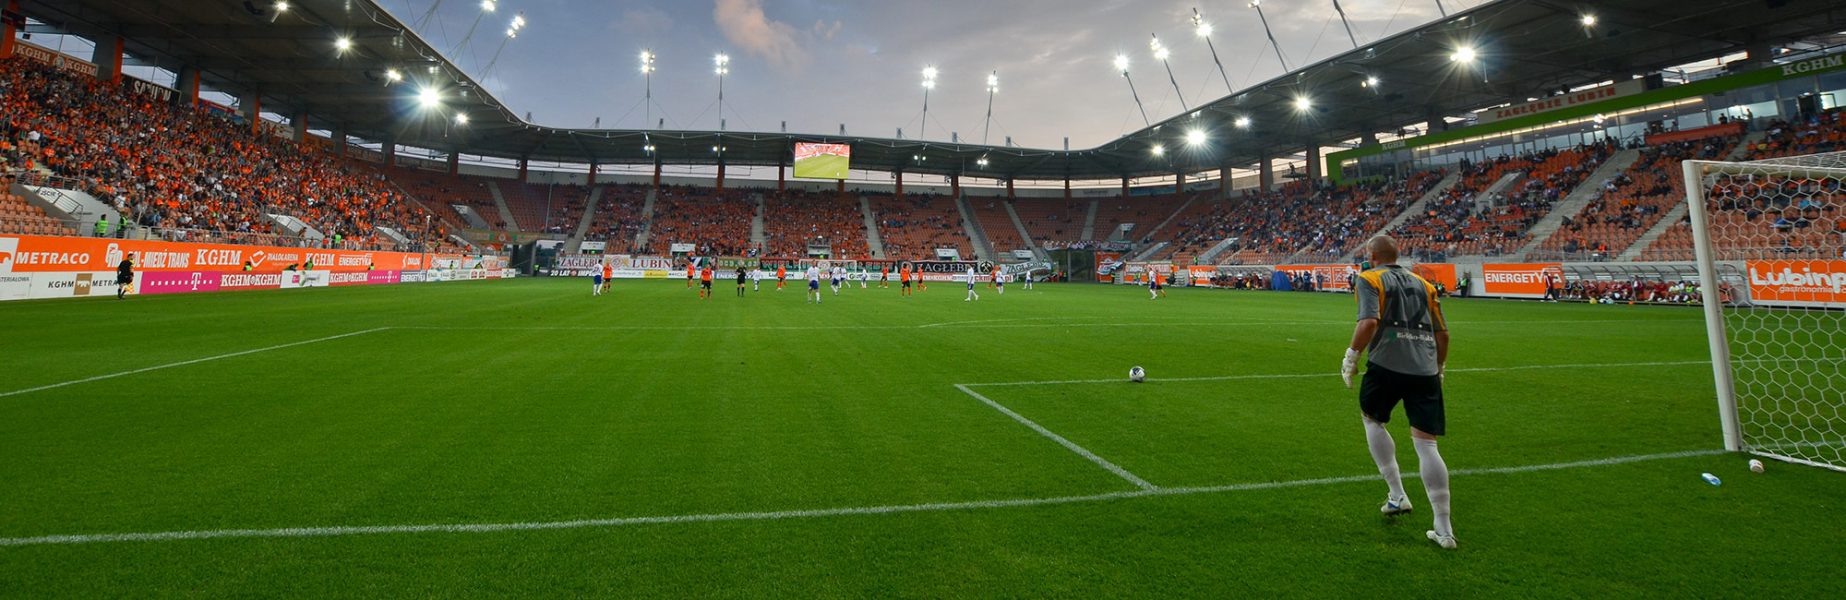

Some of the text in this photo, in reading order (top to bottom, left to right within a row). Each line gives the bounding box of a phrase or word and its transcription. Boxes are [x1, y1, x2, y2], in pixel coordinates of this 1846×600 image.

[17, 44, 97, 76] KGHM KGHM
[1782, 55, 1844, 76] KGHM
[1567, 87, 1616, 105] LUBIN
[15, 251, 90, 265] METRACO
[167, 252, 190, 268] TRANS
[195, 249, 242, 265] KGHM
[305, 253, 335, 266] KGHM
[632, 258, 671, 269] LUBIN
[220, 273, 282, 287] KGHM KGHM
[1485, 271, 1562, 283] ENERGETYA
